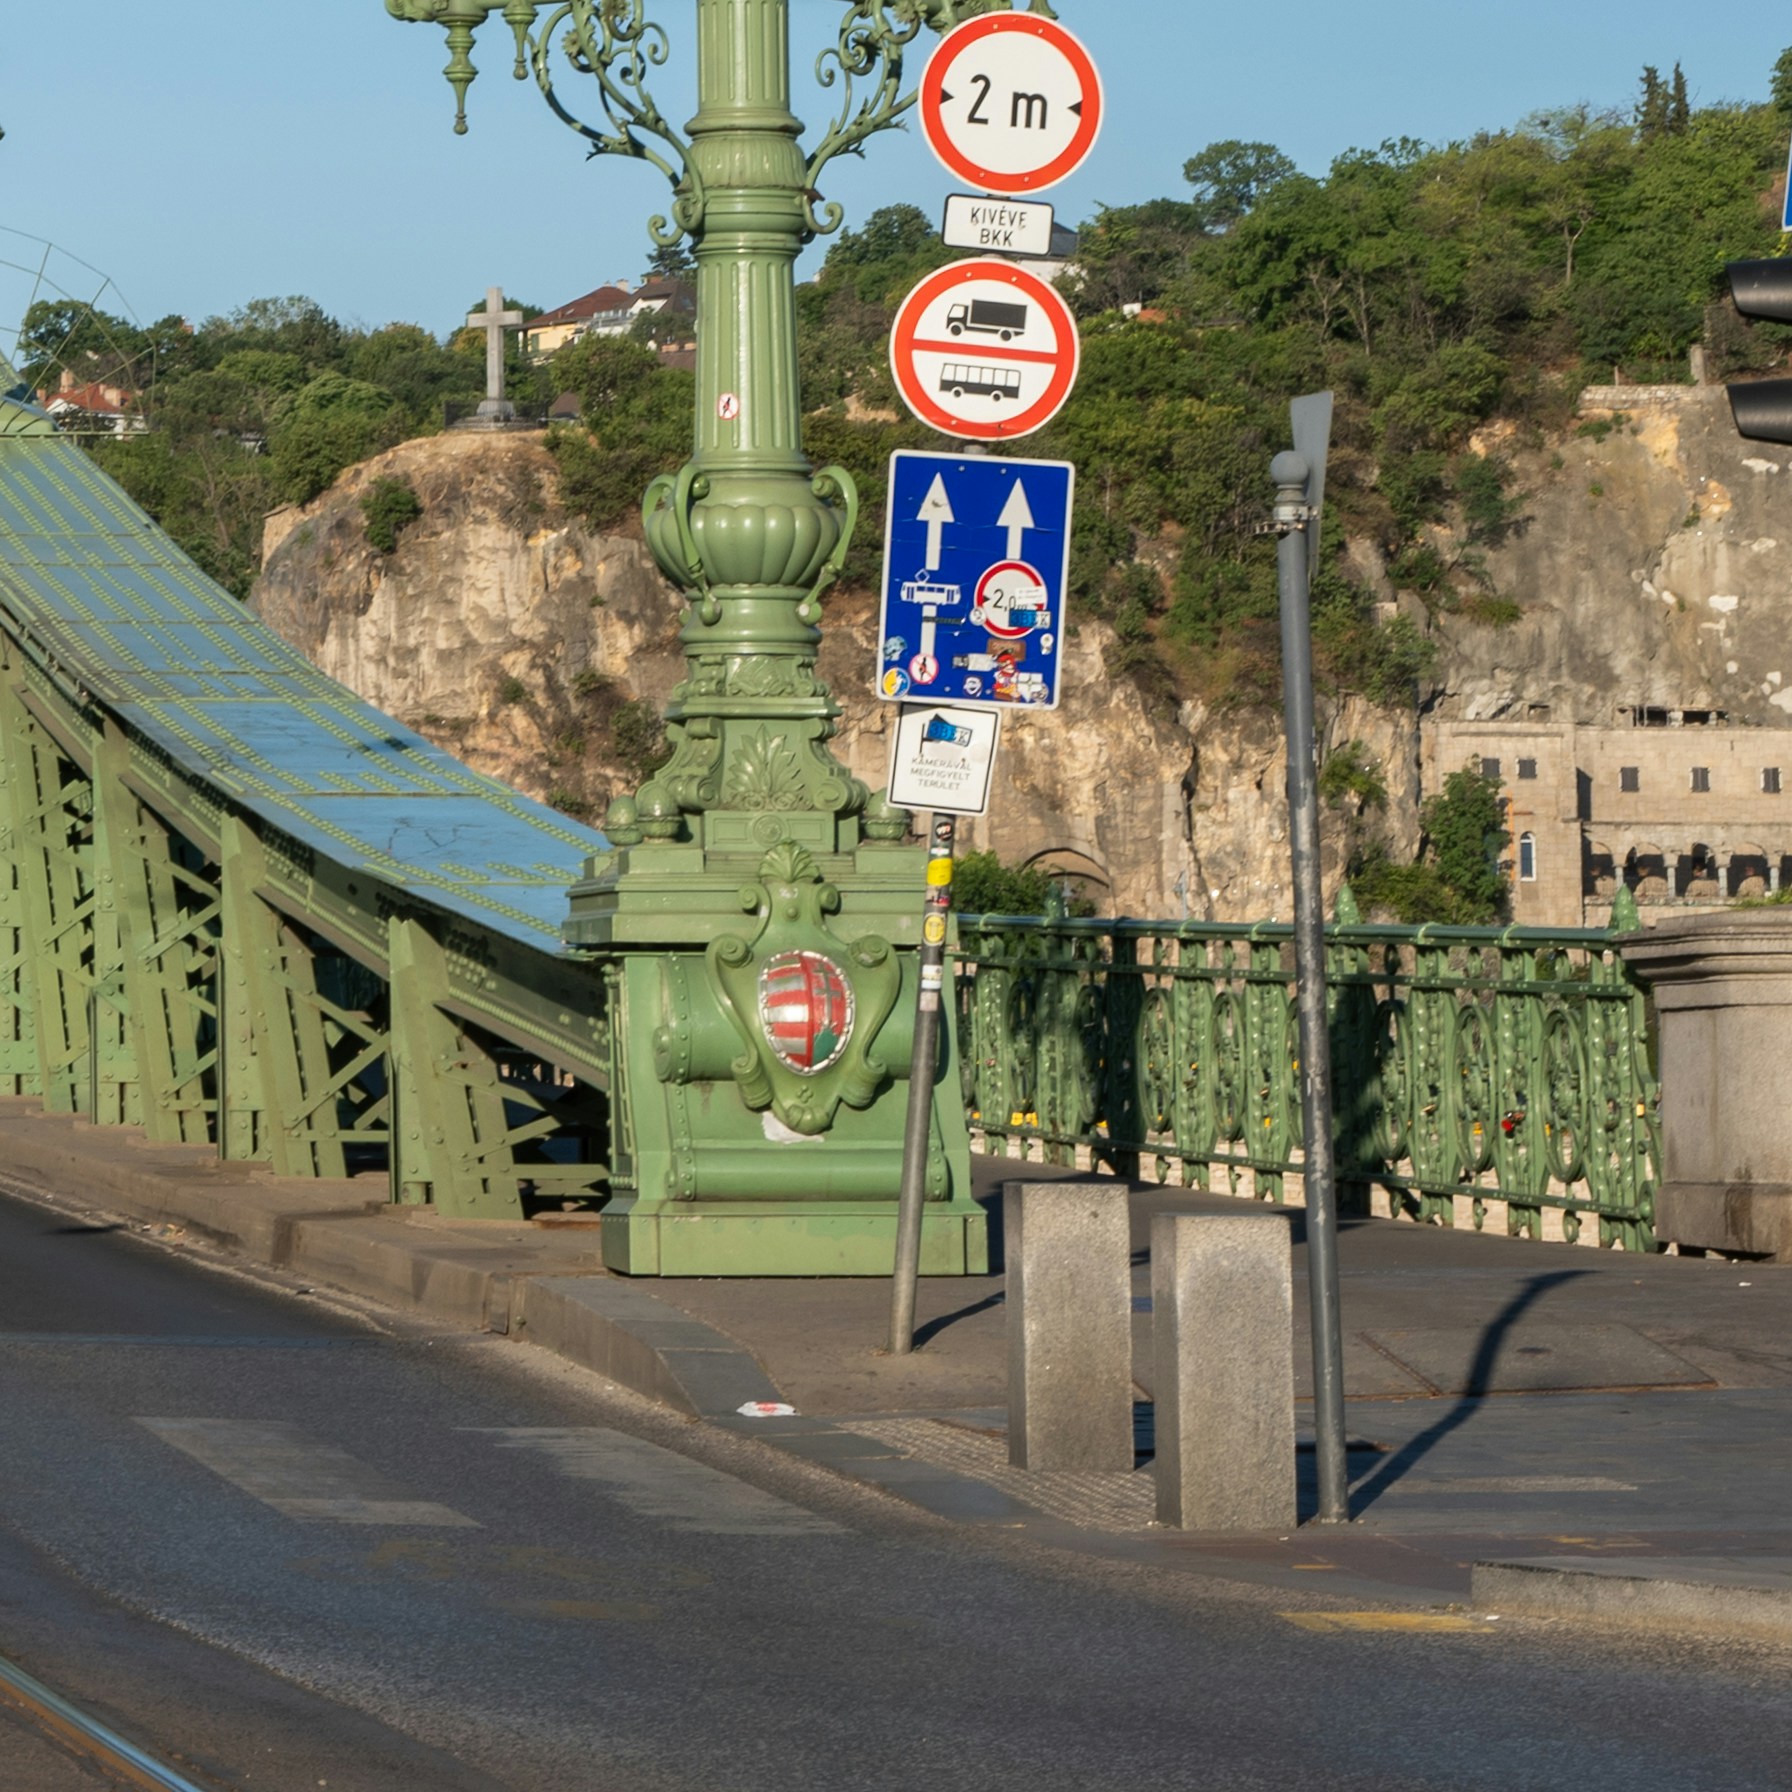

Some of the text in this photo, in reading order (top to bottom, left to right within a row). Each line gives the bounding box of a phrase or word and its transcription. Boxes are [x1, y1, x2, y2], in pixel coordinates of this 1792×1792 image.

[967, 74, 1048, 129] 2 m
[979, 228, 1013, 247] BKK
